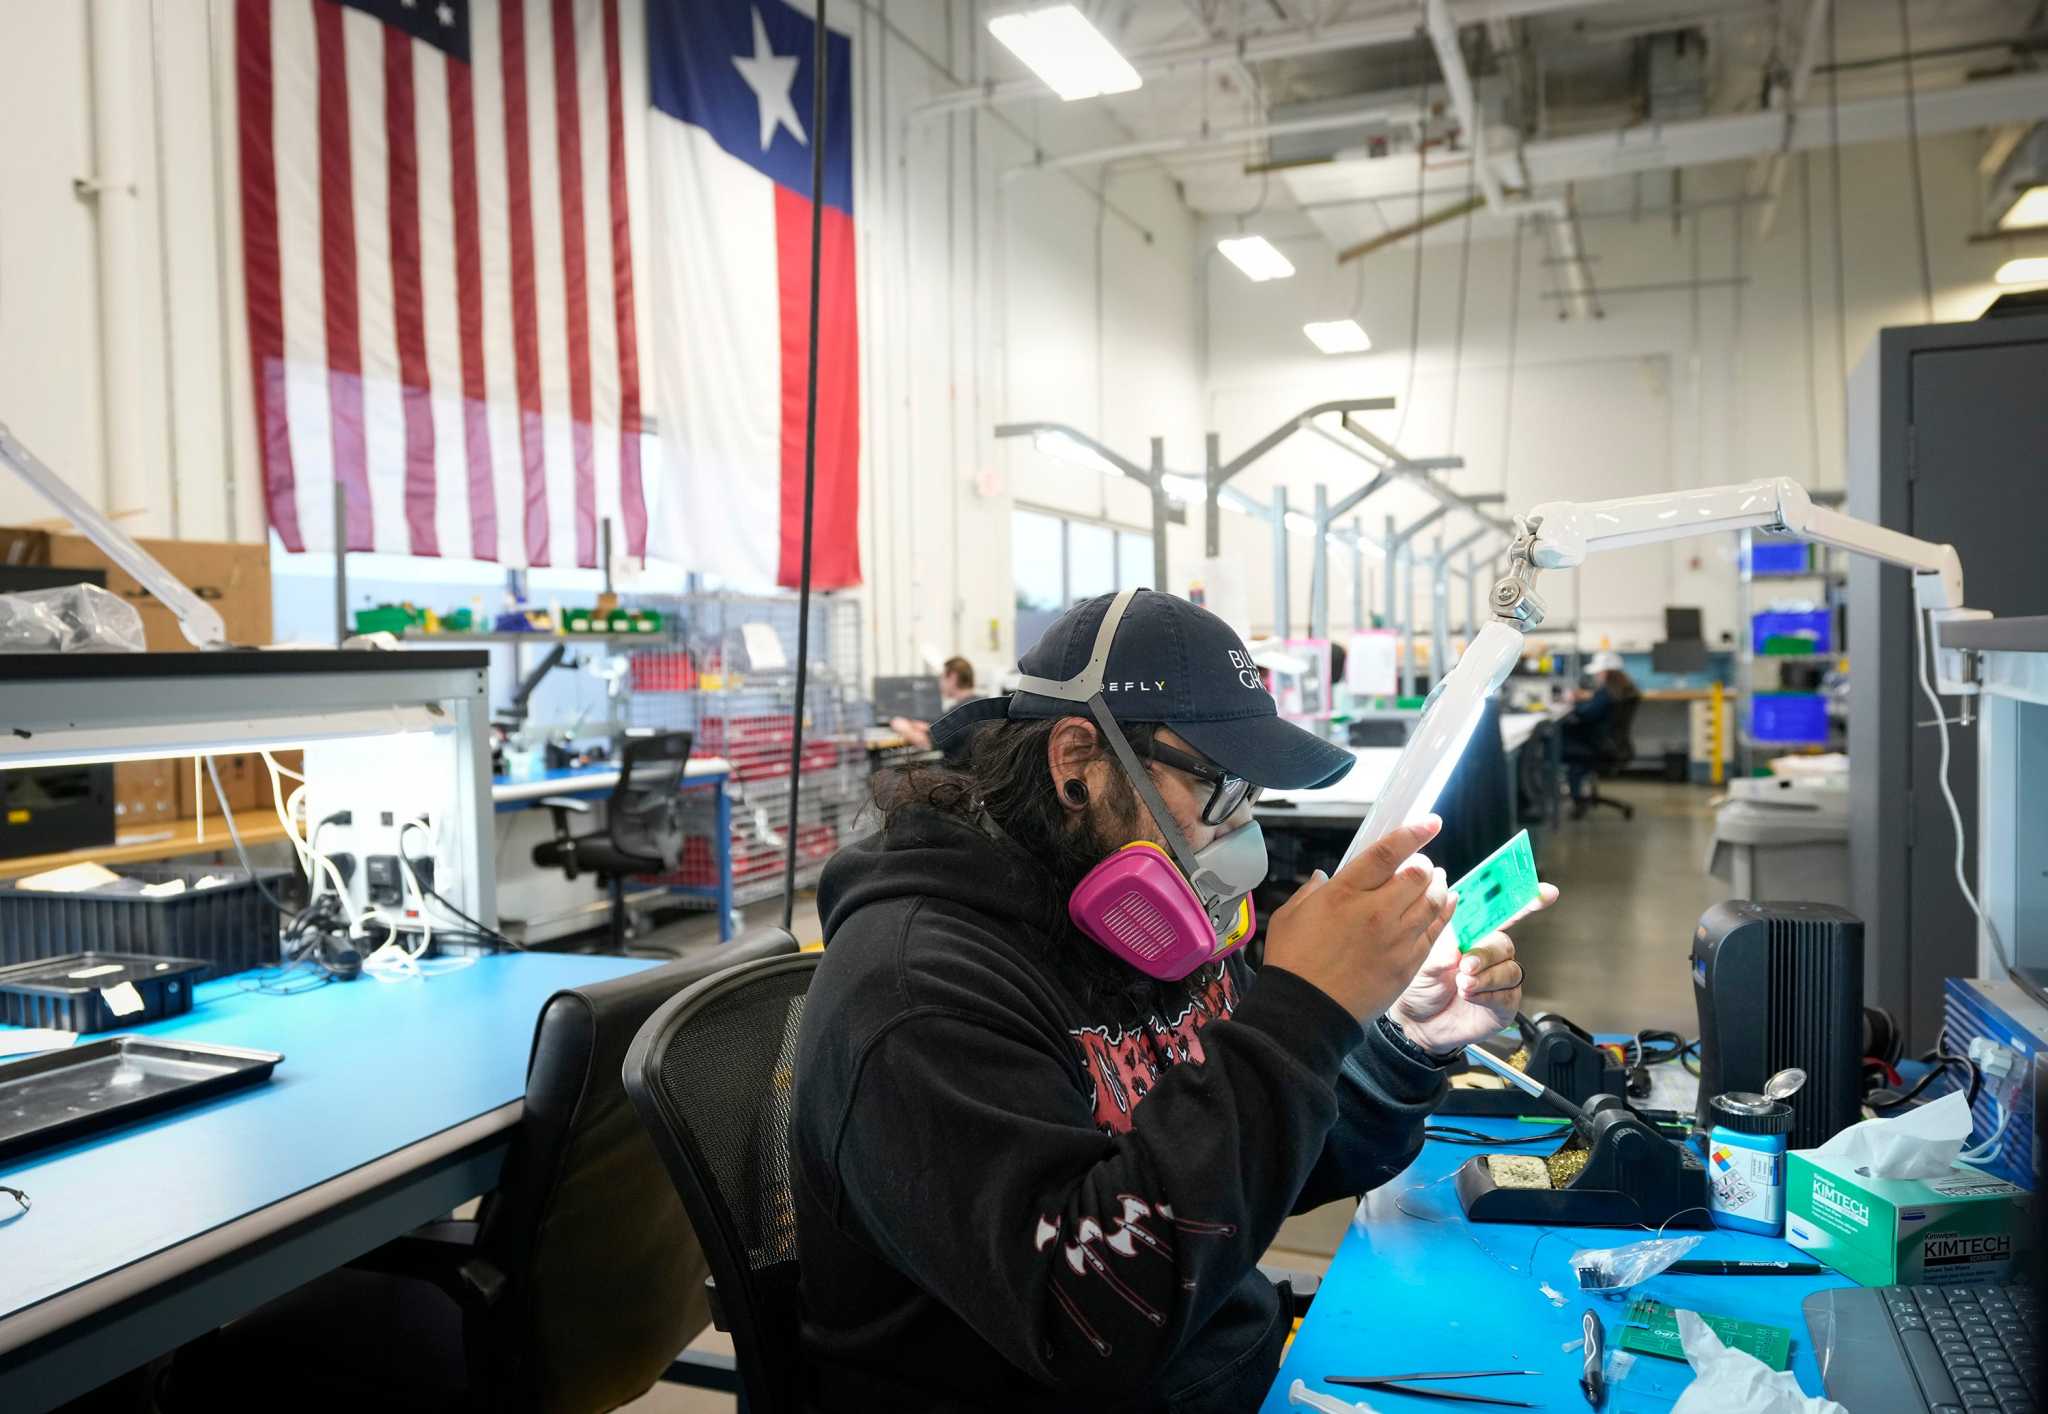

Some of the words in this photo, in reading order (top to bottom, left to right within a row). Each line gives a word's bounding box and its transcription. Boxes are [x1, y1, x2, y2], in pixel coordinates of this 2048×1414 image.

[1101, 681, 1165, 692] EFLY
[1813, 1179, 1869, 1219] KIMTECH
[1924, 1235, 2010, 1257] KIMTECH
